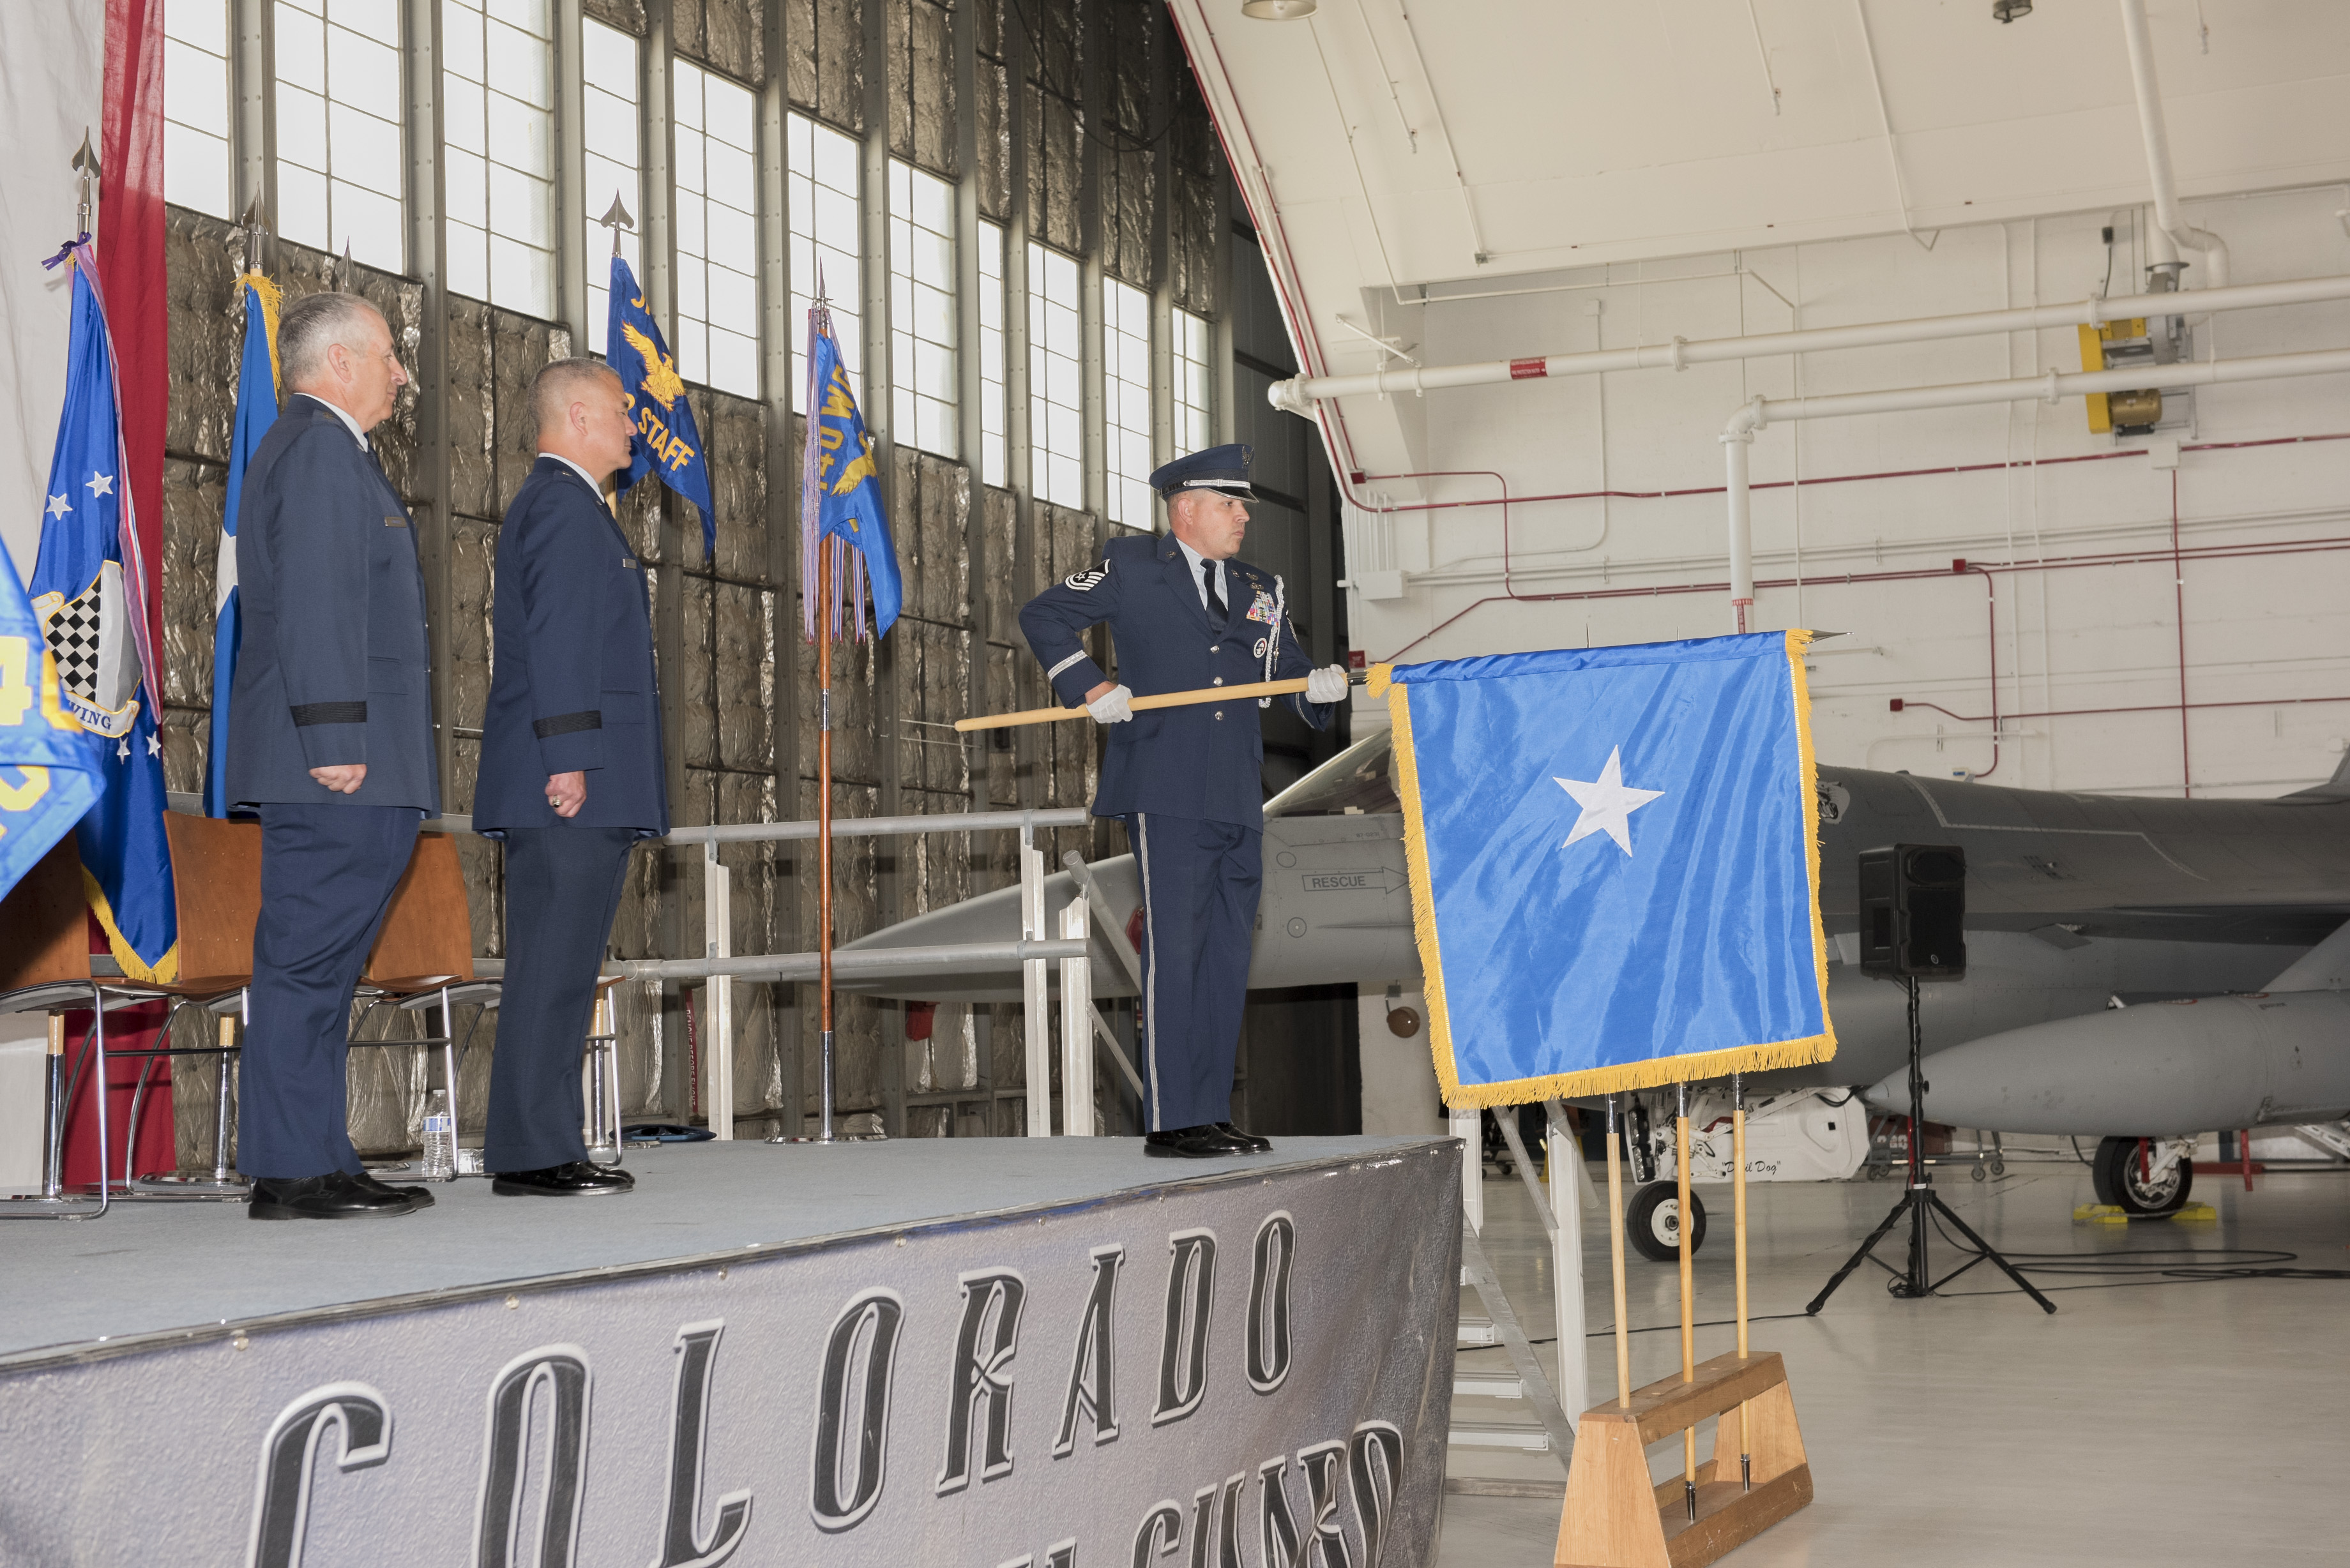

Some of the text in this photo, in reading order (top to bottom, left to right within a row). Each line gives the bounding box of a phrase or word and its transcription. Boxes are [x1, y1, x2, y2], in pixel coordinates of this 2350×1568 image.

[638, 407, 695, 472] STAFF
[1312, 875, 1366, 888] RESCUE
[1722, 1161, 1781, 1175] "Dil Dog"
[245, 1209, 1297, 1568] COLORADO
